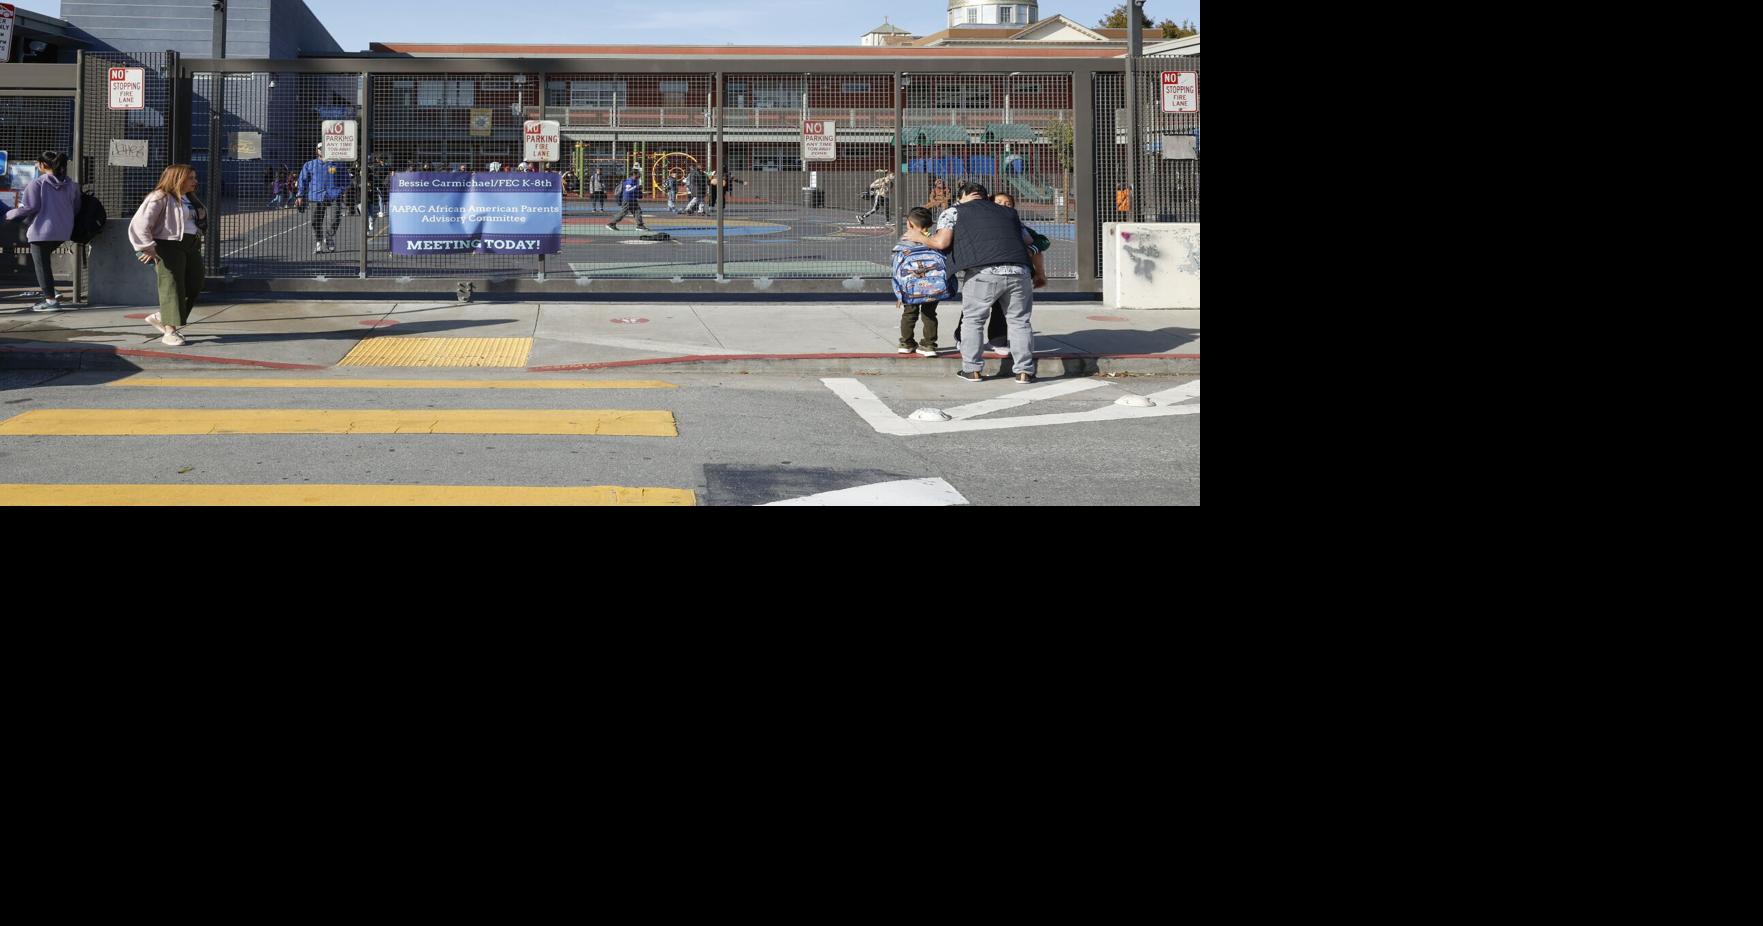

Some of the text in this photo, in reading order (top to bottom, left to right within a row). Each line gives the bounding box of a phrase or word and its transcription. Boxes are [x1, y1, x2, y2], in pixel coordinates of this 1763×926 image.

[112, 70, 124, 79] NO
[1164, 73, 1176, 83] NO
[113, 82, 141, 90] STOPPING
[1166, 86, 1194, 94] STOPPING
[326, 123, 343, 134] NO
[527, 123, 540, 133] NO
[806, 123, 822, 133] NO
[527, 135, 558, 143] PARKING
[399, 179, 552, 187] Bessie Carmichael/FEC K-8th
[392, 205, 560, 213] AAPAC African American Parents
[421, 214, 527, 224] Advisory Committee
[407, 239, 541, 250] MEETING TODAY!
